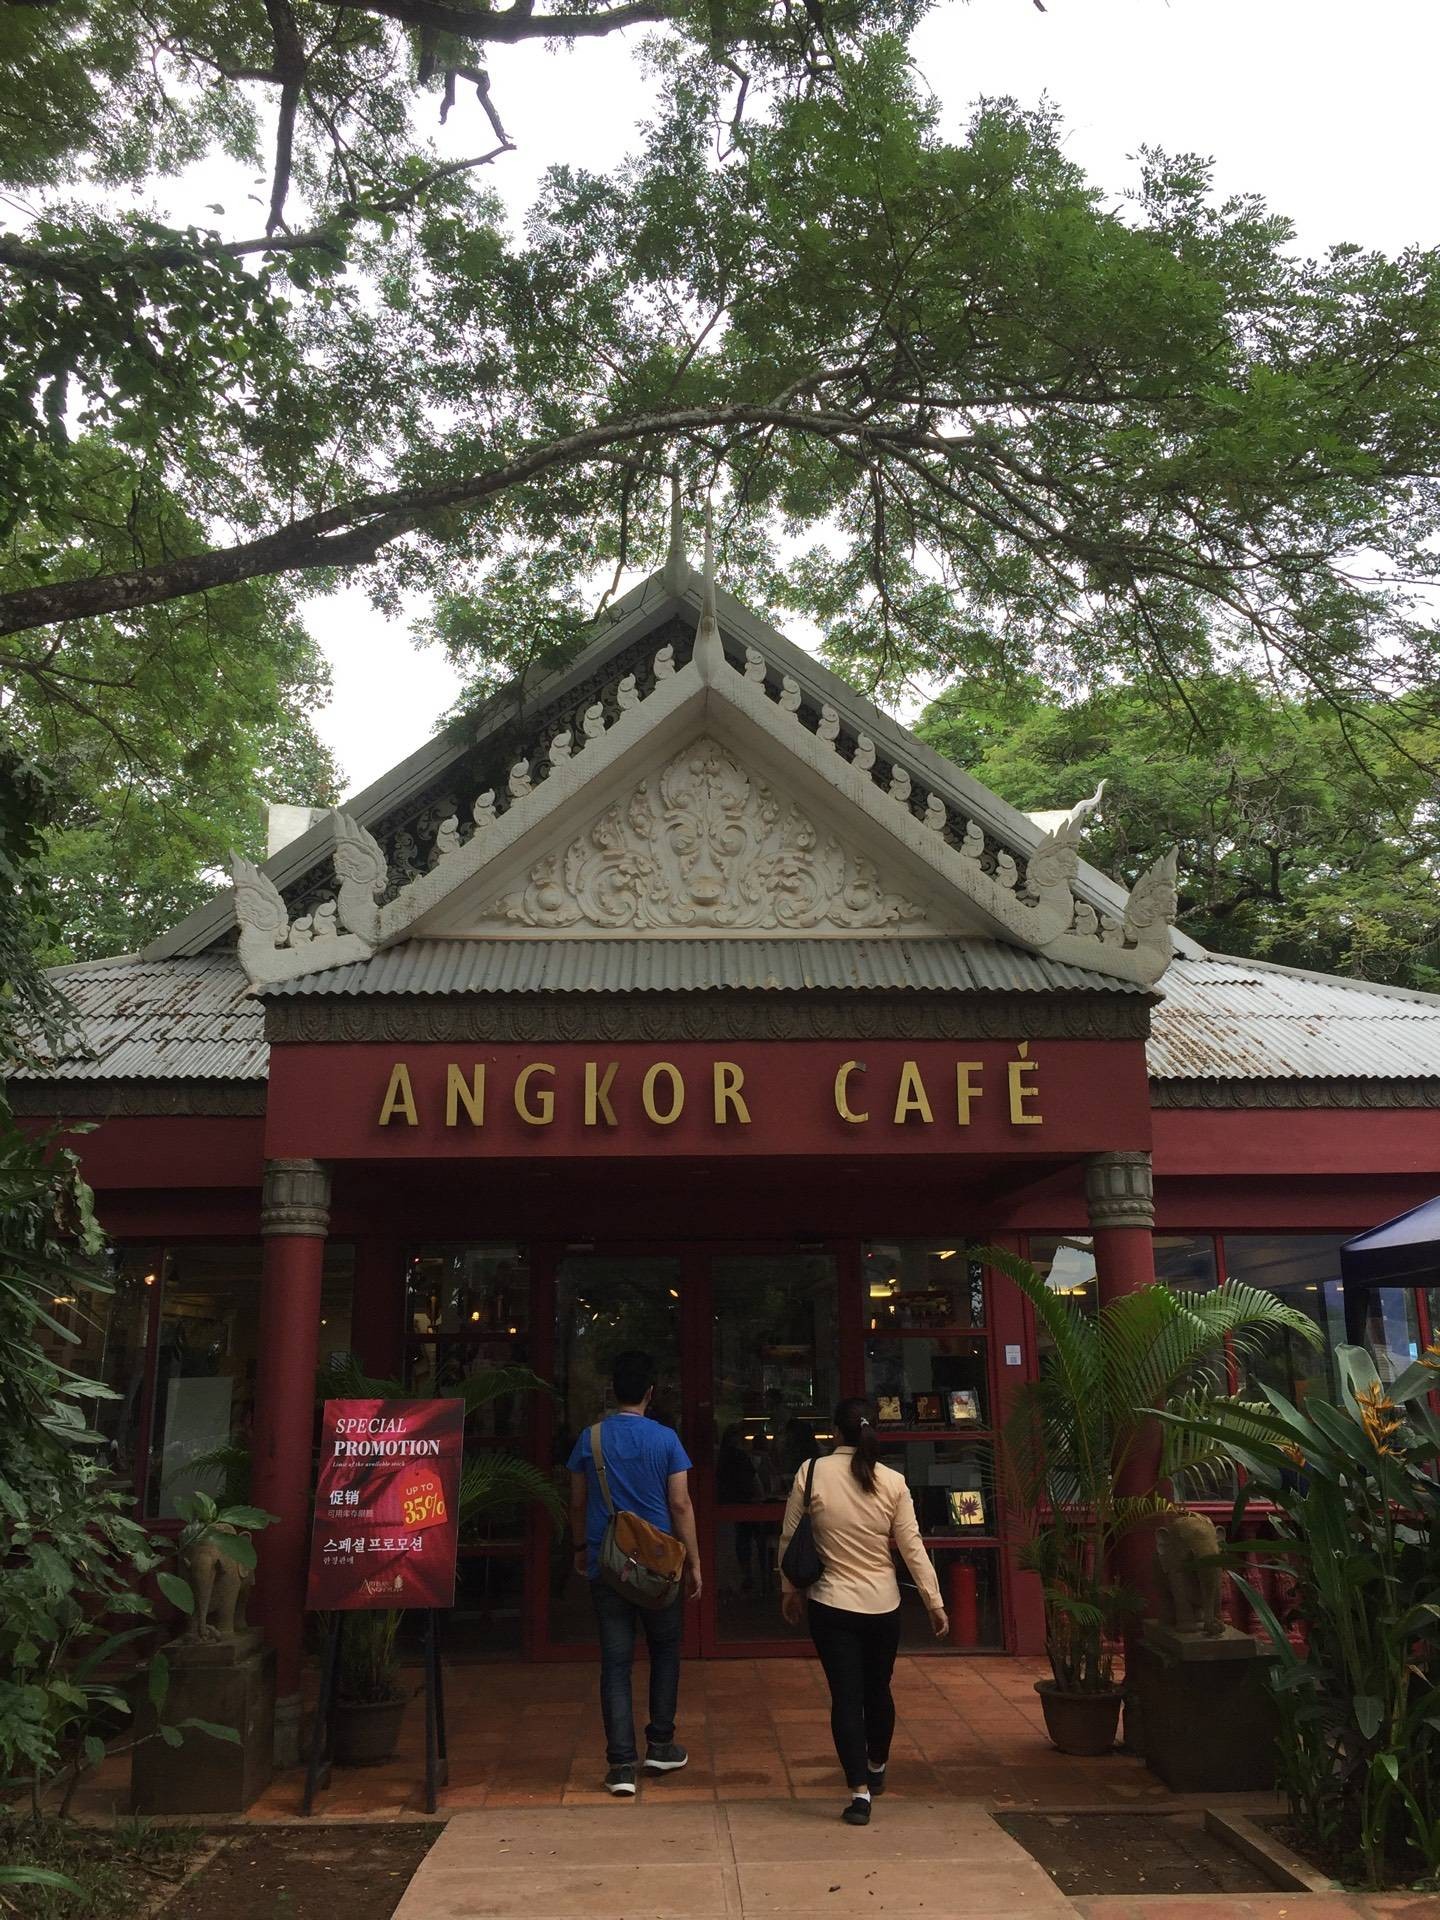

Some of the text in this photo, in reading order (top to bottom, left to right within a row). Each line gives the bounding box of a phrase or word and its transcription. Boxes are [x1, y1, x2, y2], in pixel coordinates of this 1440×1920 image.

[378, 1040, 1043, 1126] ANGKOR CAFÉ
[335, 1418, 408, 1434] SPECIAL
[333, 1440, 441, 1457] PROMOTION
[329, 1489, 361, 1506] 促销
[406, 1482, 434, 1496] UP TO
[403, 1491, 445, 1524] 35%
[323, 1536, 423, 1553] 스페셜 프로모션
